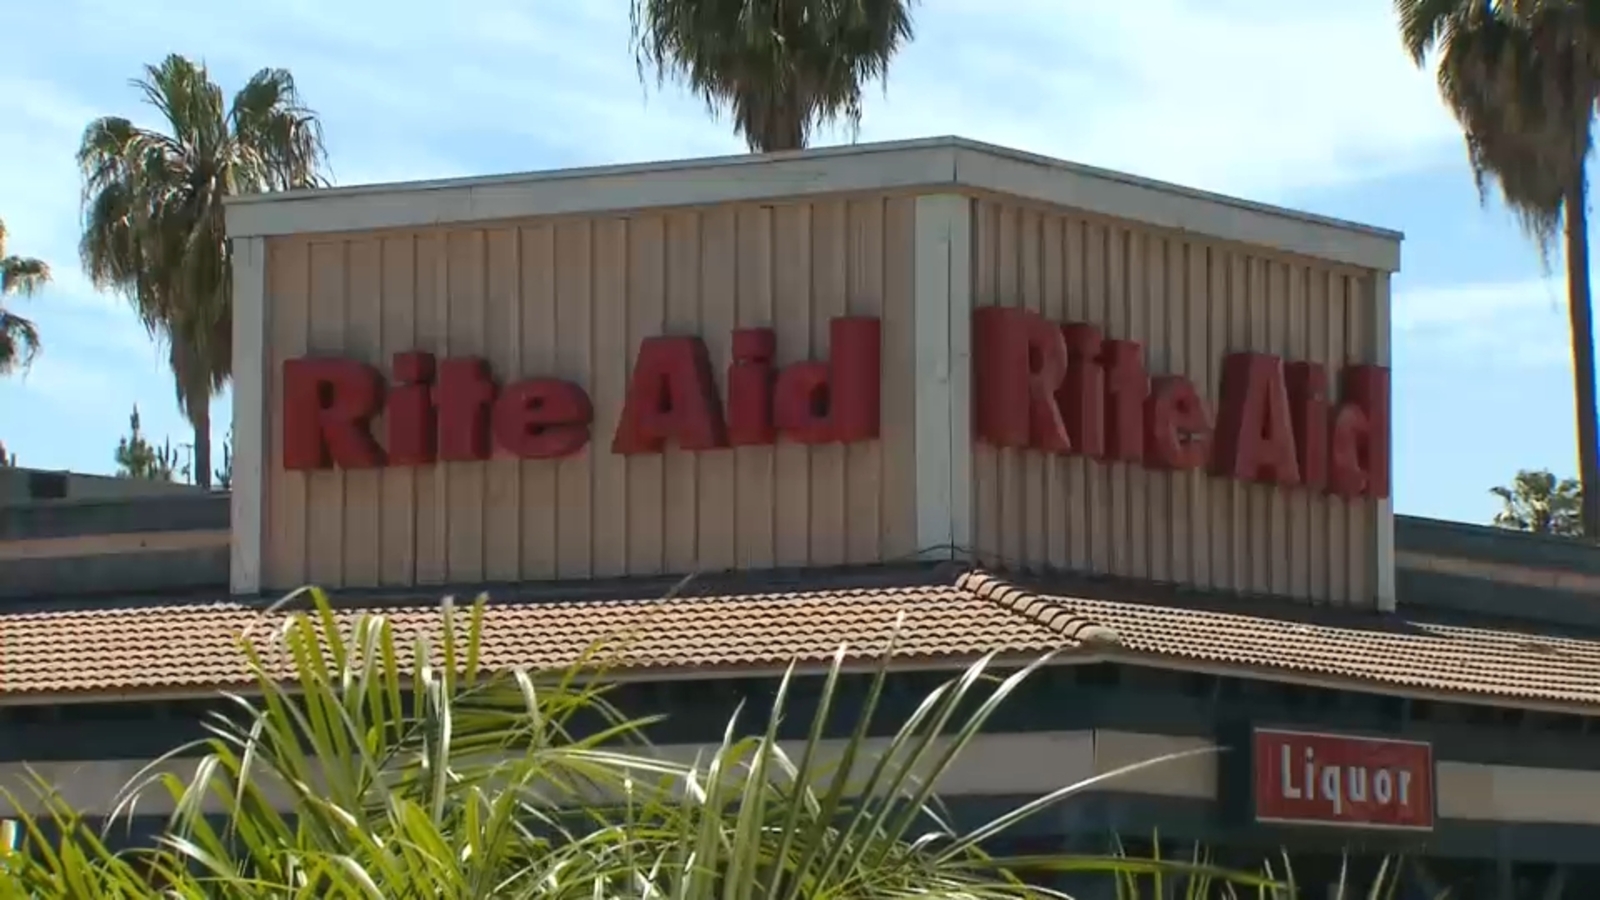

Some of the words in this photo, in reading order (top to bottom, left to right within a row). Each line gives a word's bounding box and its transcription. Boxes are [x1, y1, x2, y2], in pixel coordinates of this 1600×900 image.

[282, 351, 593, 471] Rite
[612, 316, 881, 454] Aid
[975, 306, 1216, 470] Rite
[1216, 351, 1391, 499] Aid
[1282, 744, 1411, 815] Liquor
